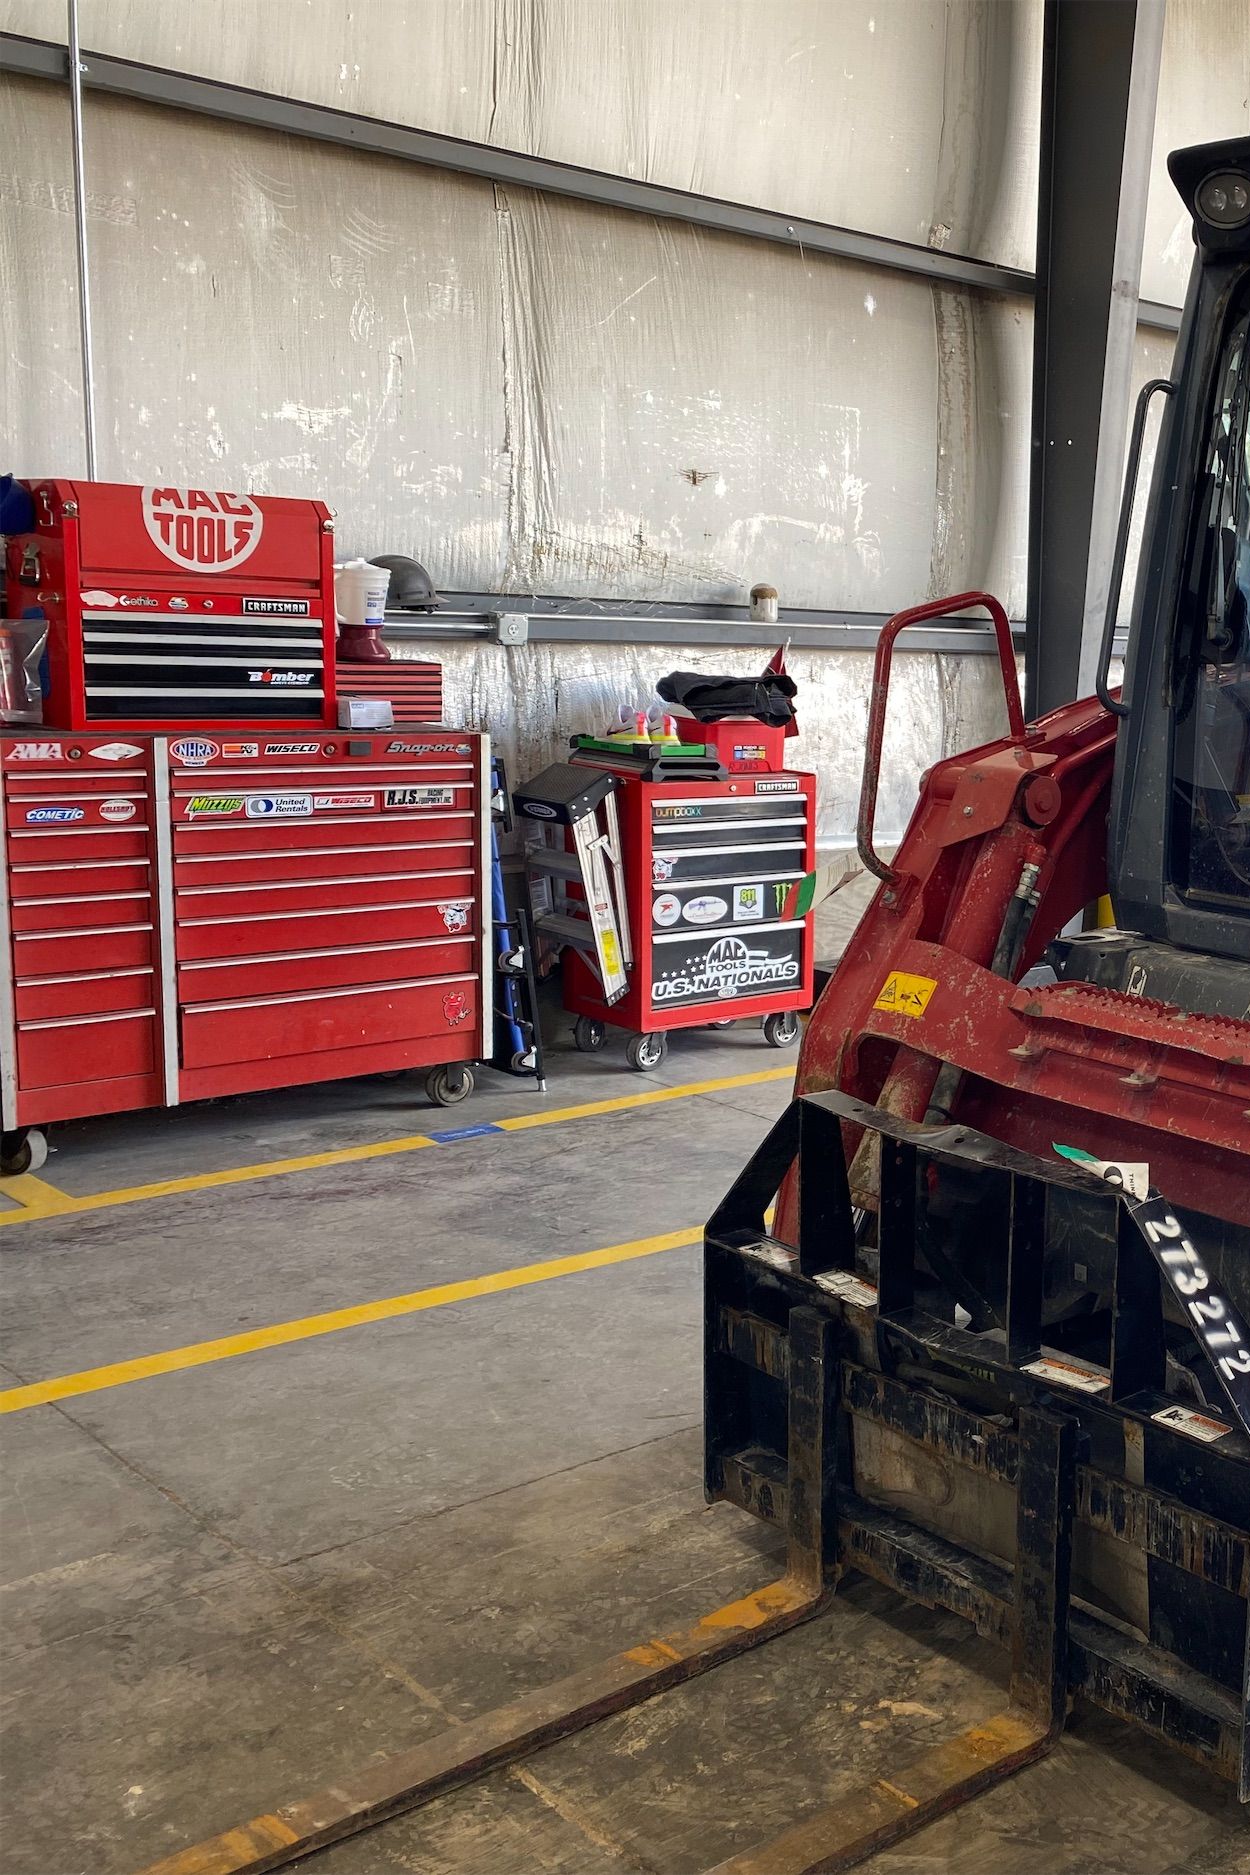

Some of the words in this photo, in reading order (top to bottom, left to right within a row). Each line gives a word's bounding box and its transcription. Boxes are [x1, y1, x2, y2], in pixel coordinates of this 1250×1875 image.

[151, 486, 254, 516] MAC
[152, 511, 254, 564] TOOLS
[130, 596, 159, 607] ethika
[247, 601, 306, 613] CRAFTSMAN
[247, 670, 315, 682] Bomber
[5, 742, 64, 760] AMA
[179, 742, 213, 757] NHRA
[266, 744, 318, 753] WISECO
[386, 741, 456, 756] Snap-on
[758, 782, 797, 791] CRAFTSMAN
[275, 797, 306, 806] United
[26, 807, 85, 821] COMETIC
[275, 805, 309, 813] Rentals
[740, 888, 757, 902] 811
[708, 939, 747, 965] MAC
[708, 960, 746, 974] TOOLS
[654, 980, 691, 997] U.S.
[696, 964, 797, 991] NATIONALS
